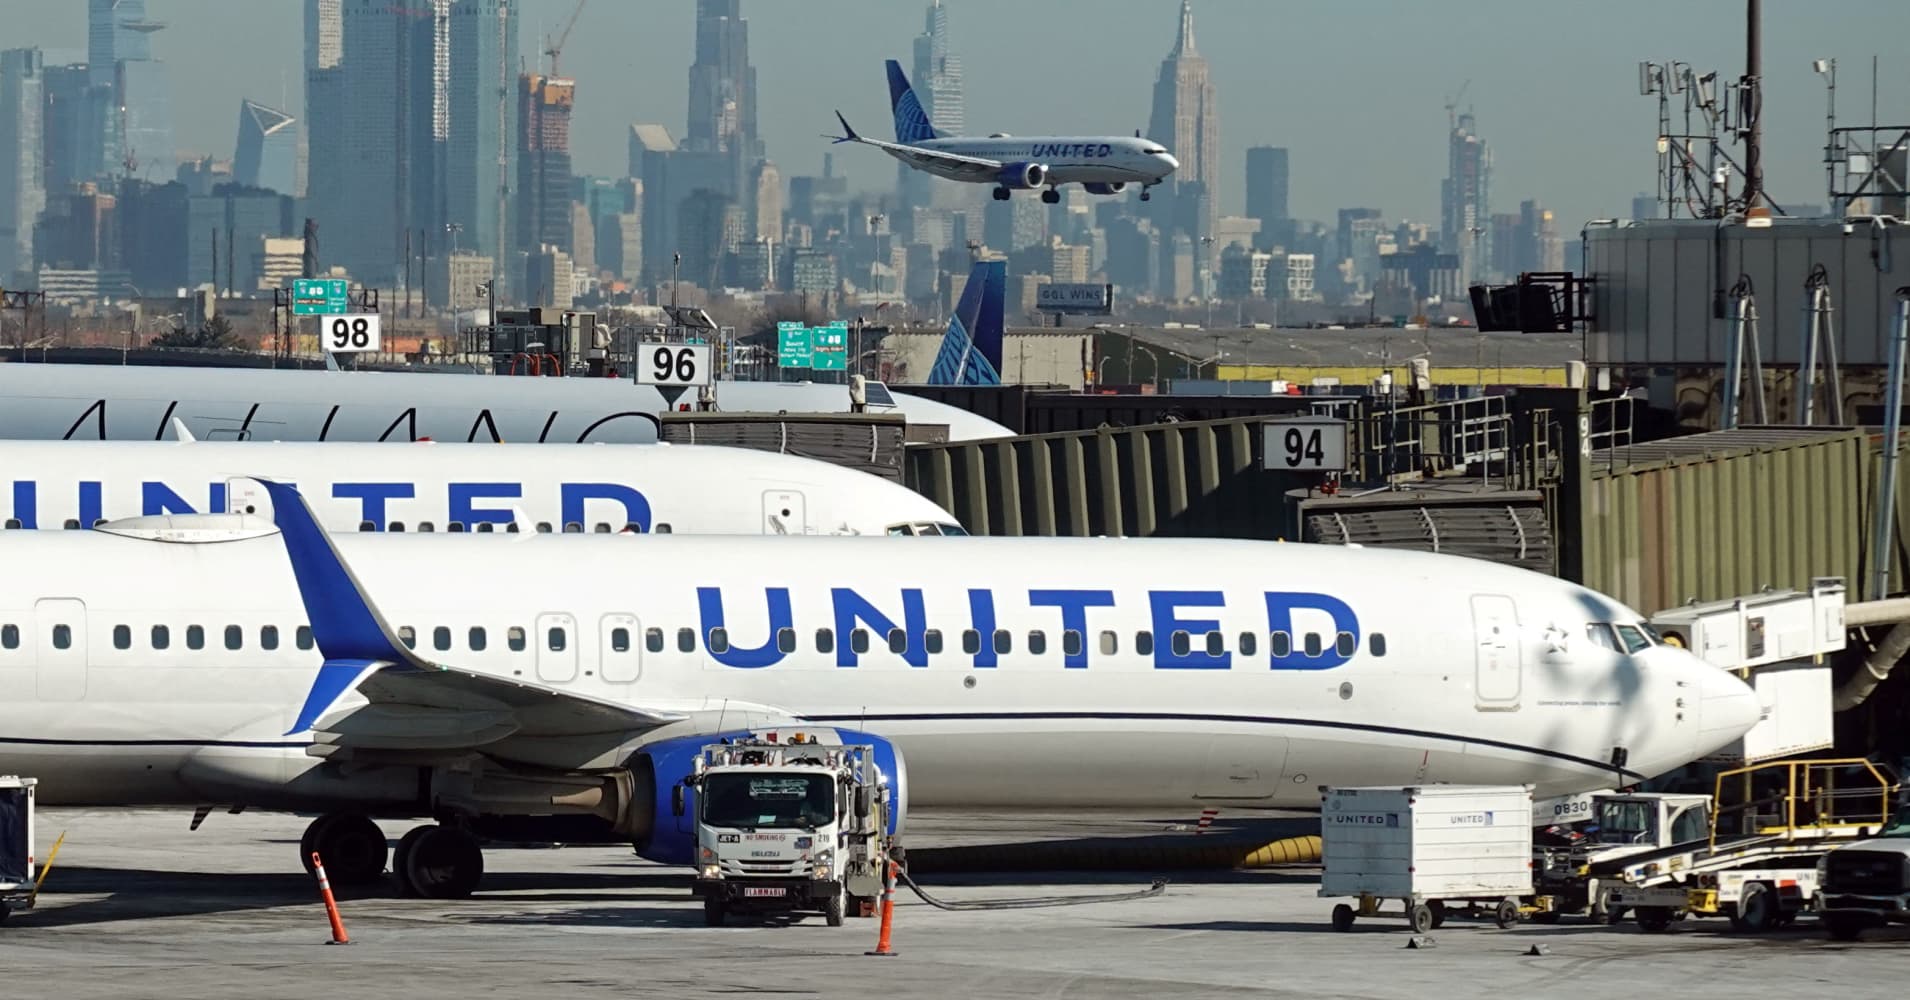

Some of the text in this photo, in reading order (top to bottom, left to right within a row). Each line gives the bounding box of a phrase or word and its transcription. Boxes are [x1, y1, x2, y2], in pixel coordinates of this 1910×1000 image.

[1032, 143, 1112, 158] UNITED
[332, 318, 369, 349] 98
[653, 347, 696, 382] 96
[1284, 427, 1325, 467] 94
[13, 480, 652, 534] UTED
[696, 586, 1360, 670] UNITED
[1336, 815, 1384, 824] UNITED
[1450, 815, 1484, 824] UNITED
